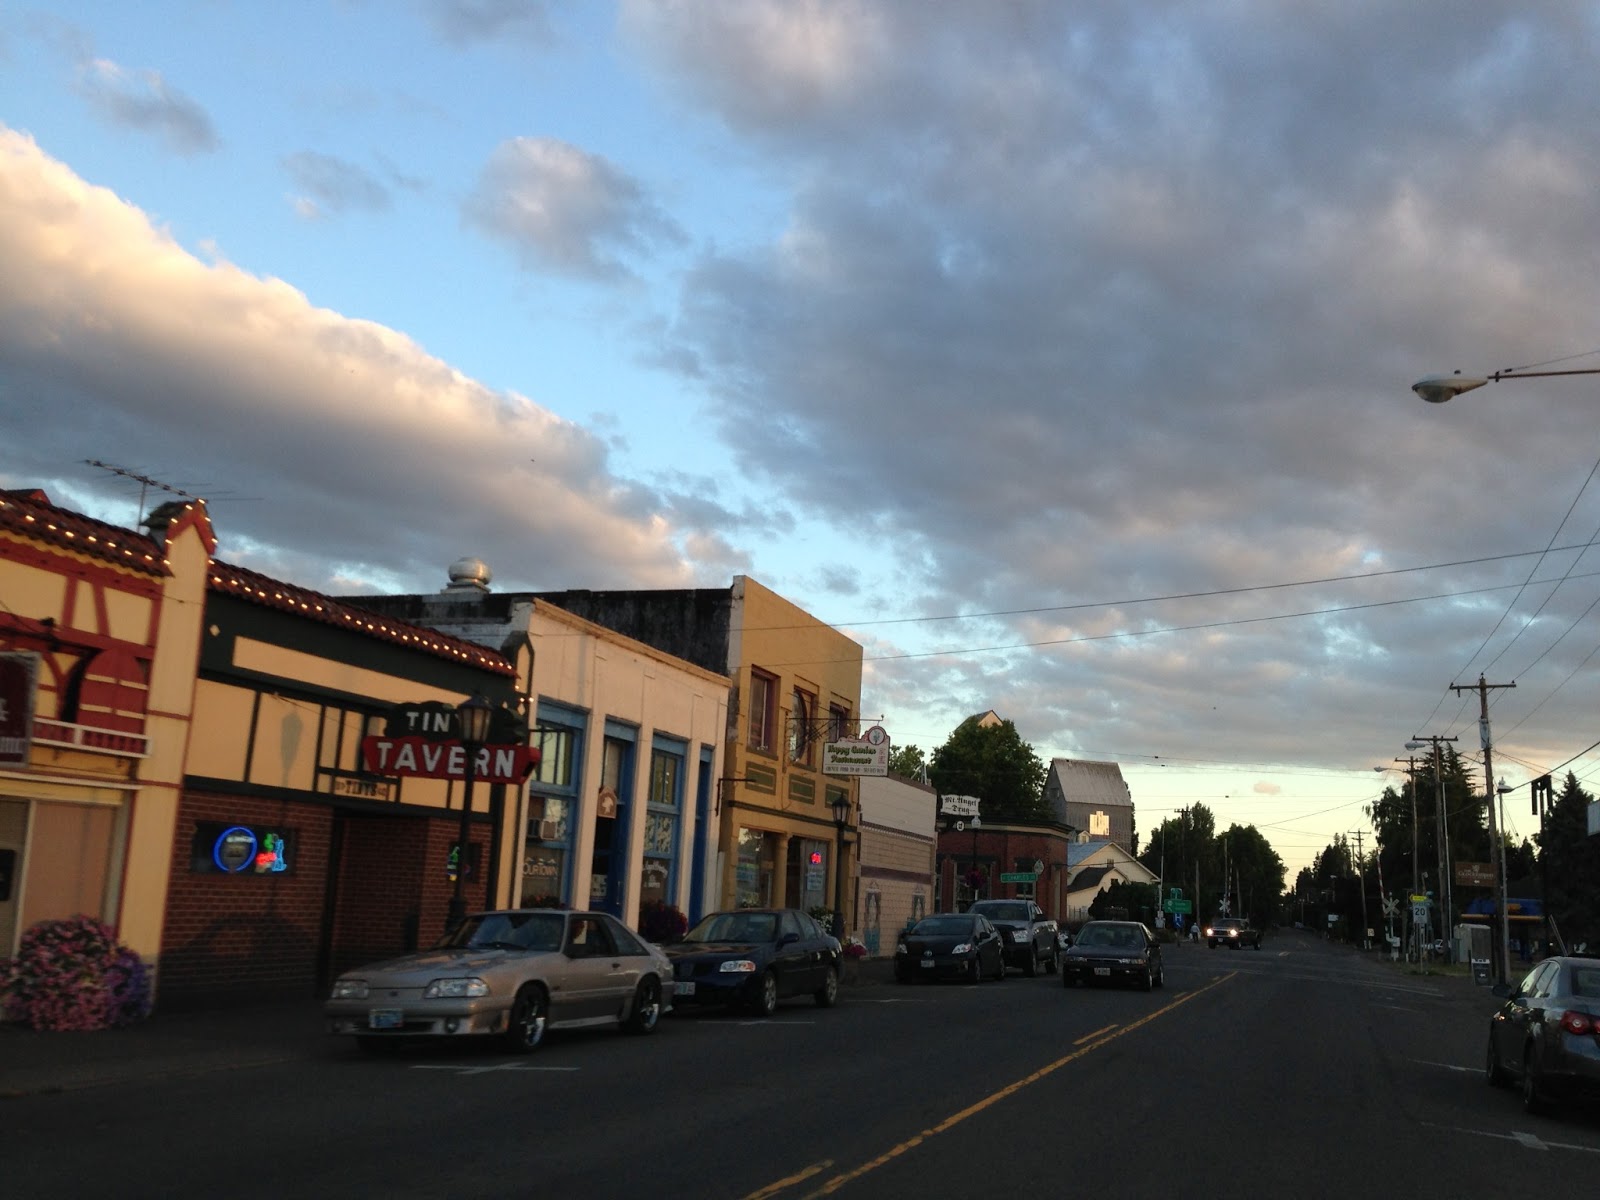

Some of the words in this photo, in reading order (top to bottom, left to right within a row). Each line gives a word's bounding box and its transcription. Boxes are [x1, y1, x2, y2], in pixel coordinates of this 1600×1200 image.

[407, 711, 459, 732] TIN
[377, 742, 515, 778] TAVERN
[952, 805, 970, 814] Drug
